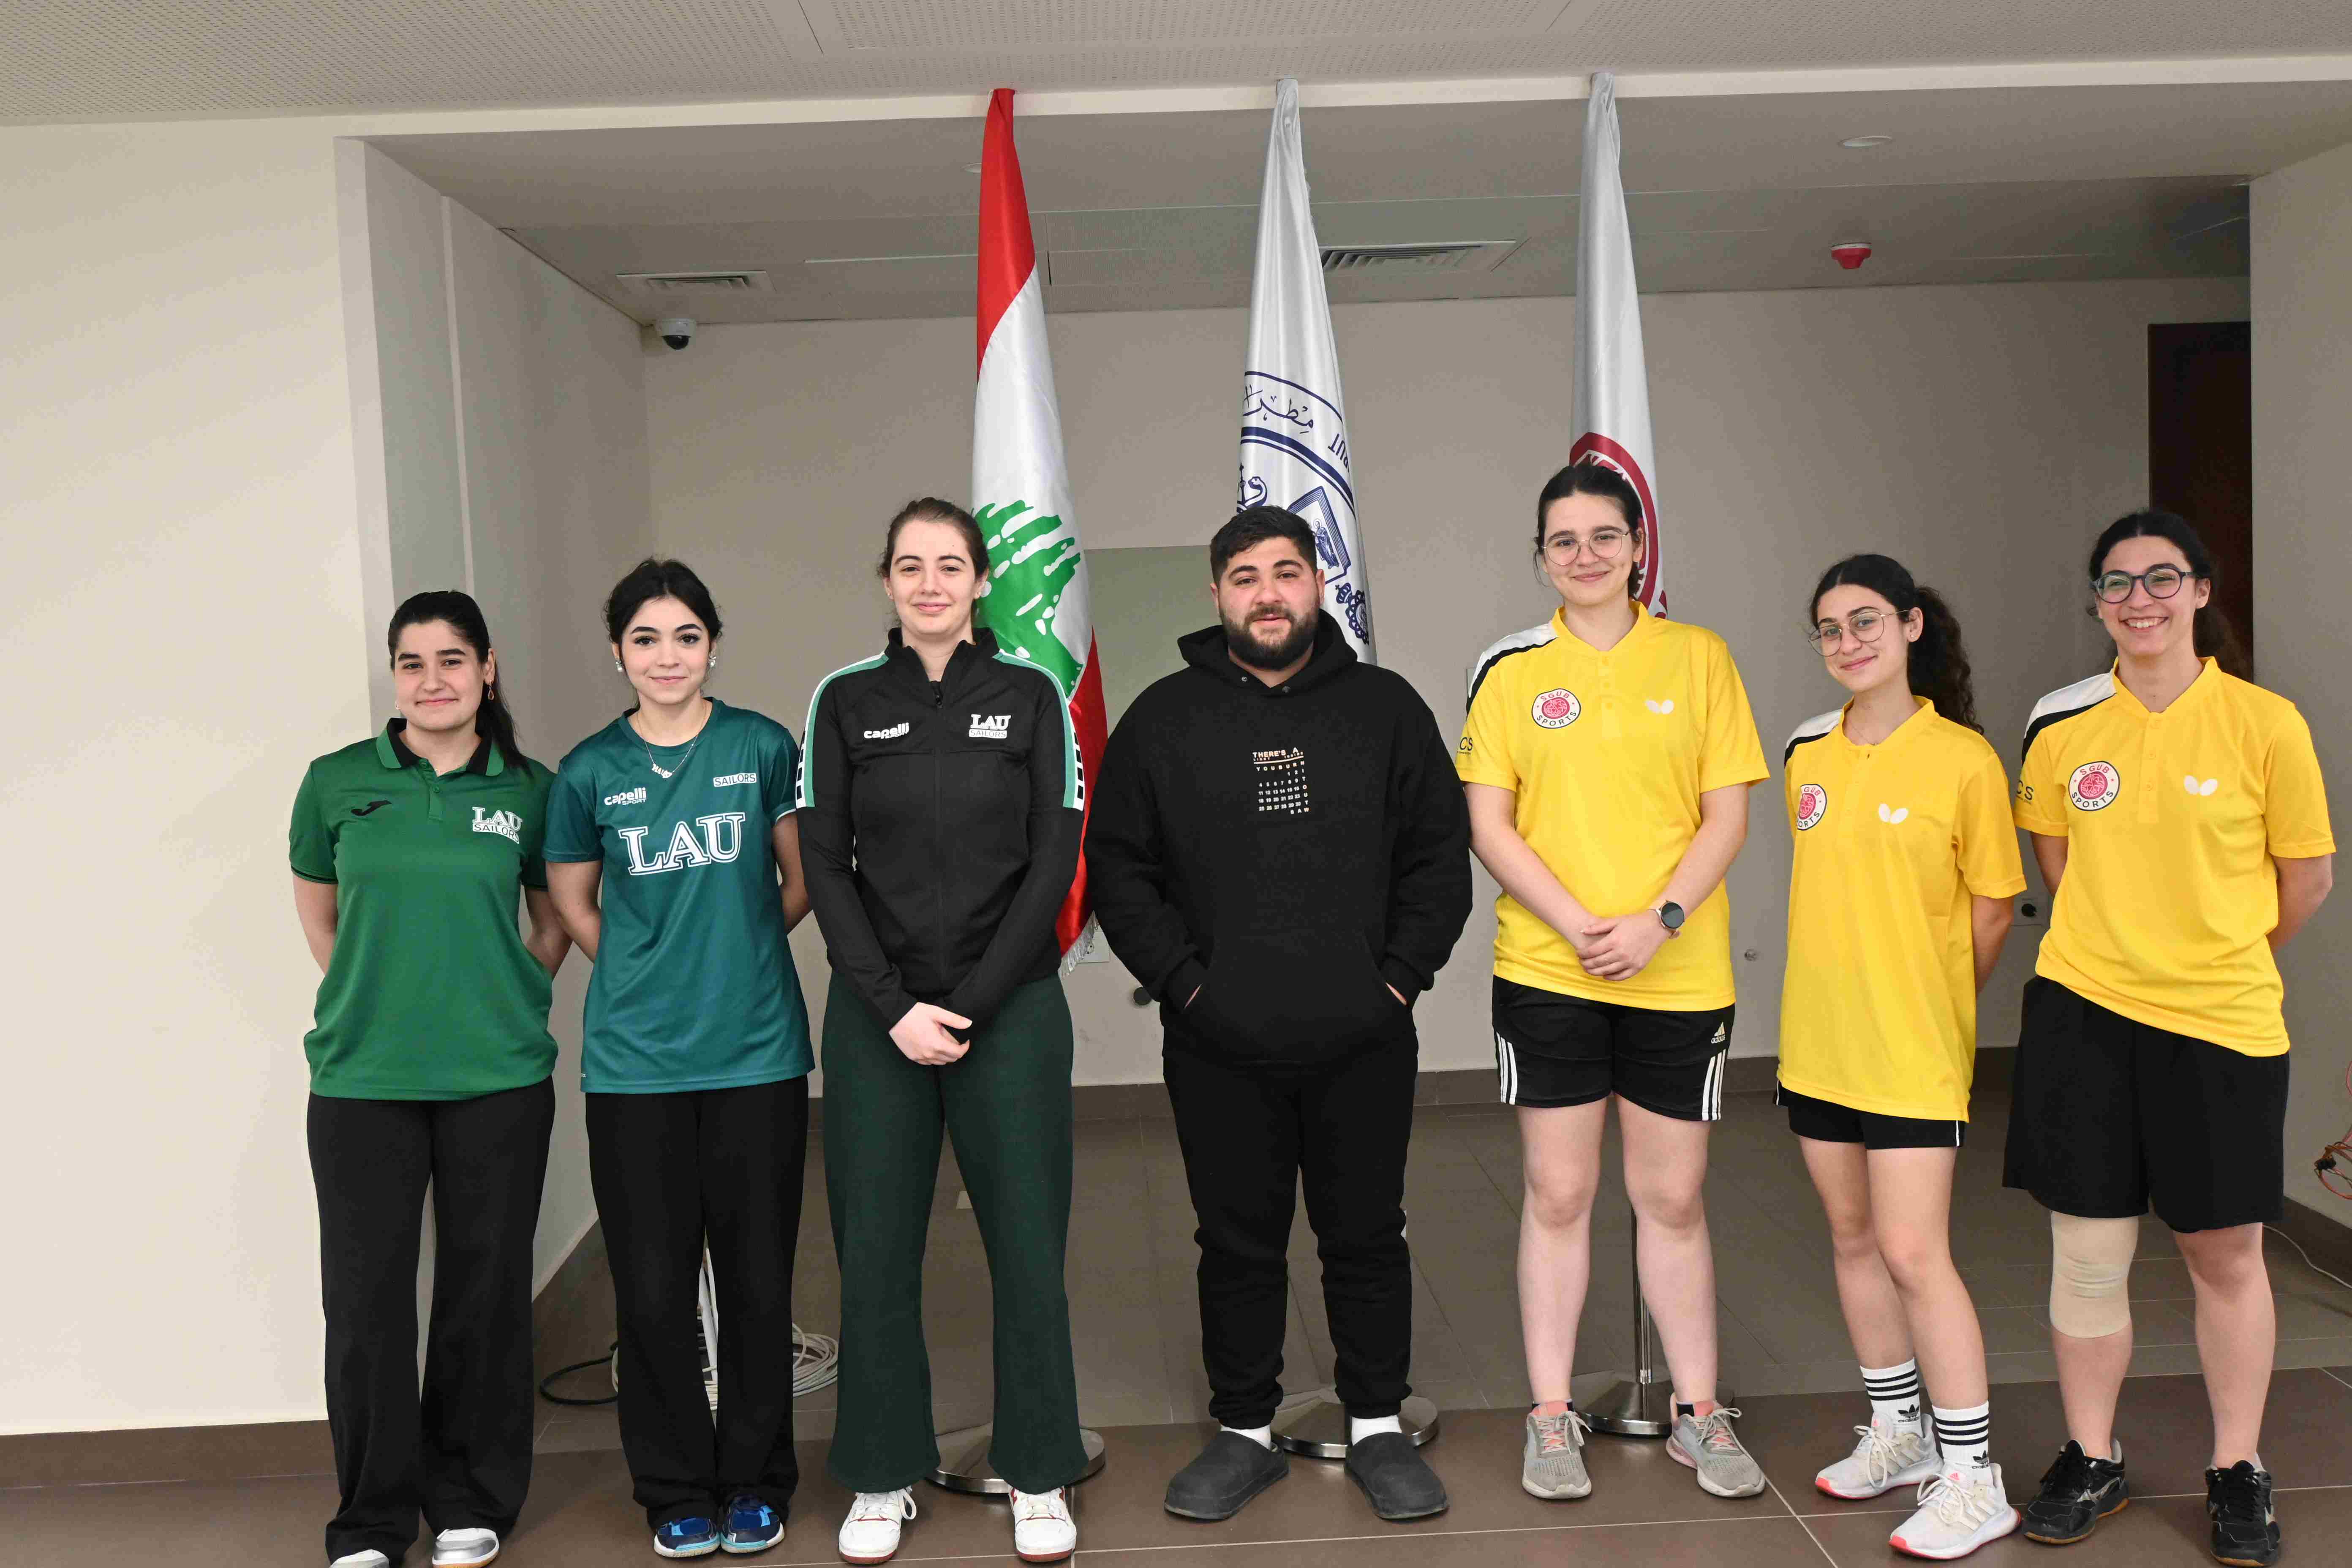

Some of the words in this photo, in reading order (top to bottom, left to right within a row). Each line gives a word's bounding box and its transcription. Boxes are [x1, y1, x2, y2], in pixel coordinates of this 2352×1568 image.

[1540, 691, 1570, 701] SGUB
[970, 714, 1011, 730] LAU
[1536, 711, 1577, 726] SPORTS
[863, 722, 909, 739] capelli
[970, 730, 1007, 738] SAILORS
[1252, 749, 1286, 758] THERE'S
[2080, 764, 2110, 776] SGUB
[714, 773, 756, 787] SAILORS
[604, 787, 647, 806] capelli
[1804, 787, 1821, 796] GUB
[621, 798, 647, 806] SPORT
[2072, 791, 2114, 808] SPORTS
[472, 806, 523, 832] LAU
[474, 824, 519, 843] SAILORS
[618, 812, 746, 876] LAU
